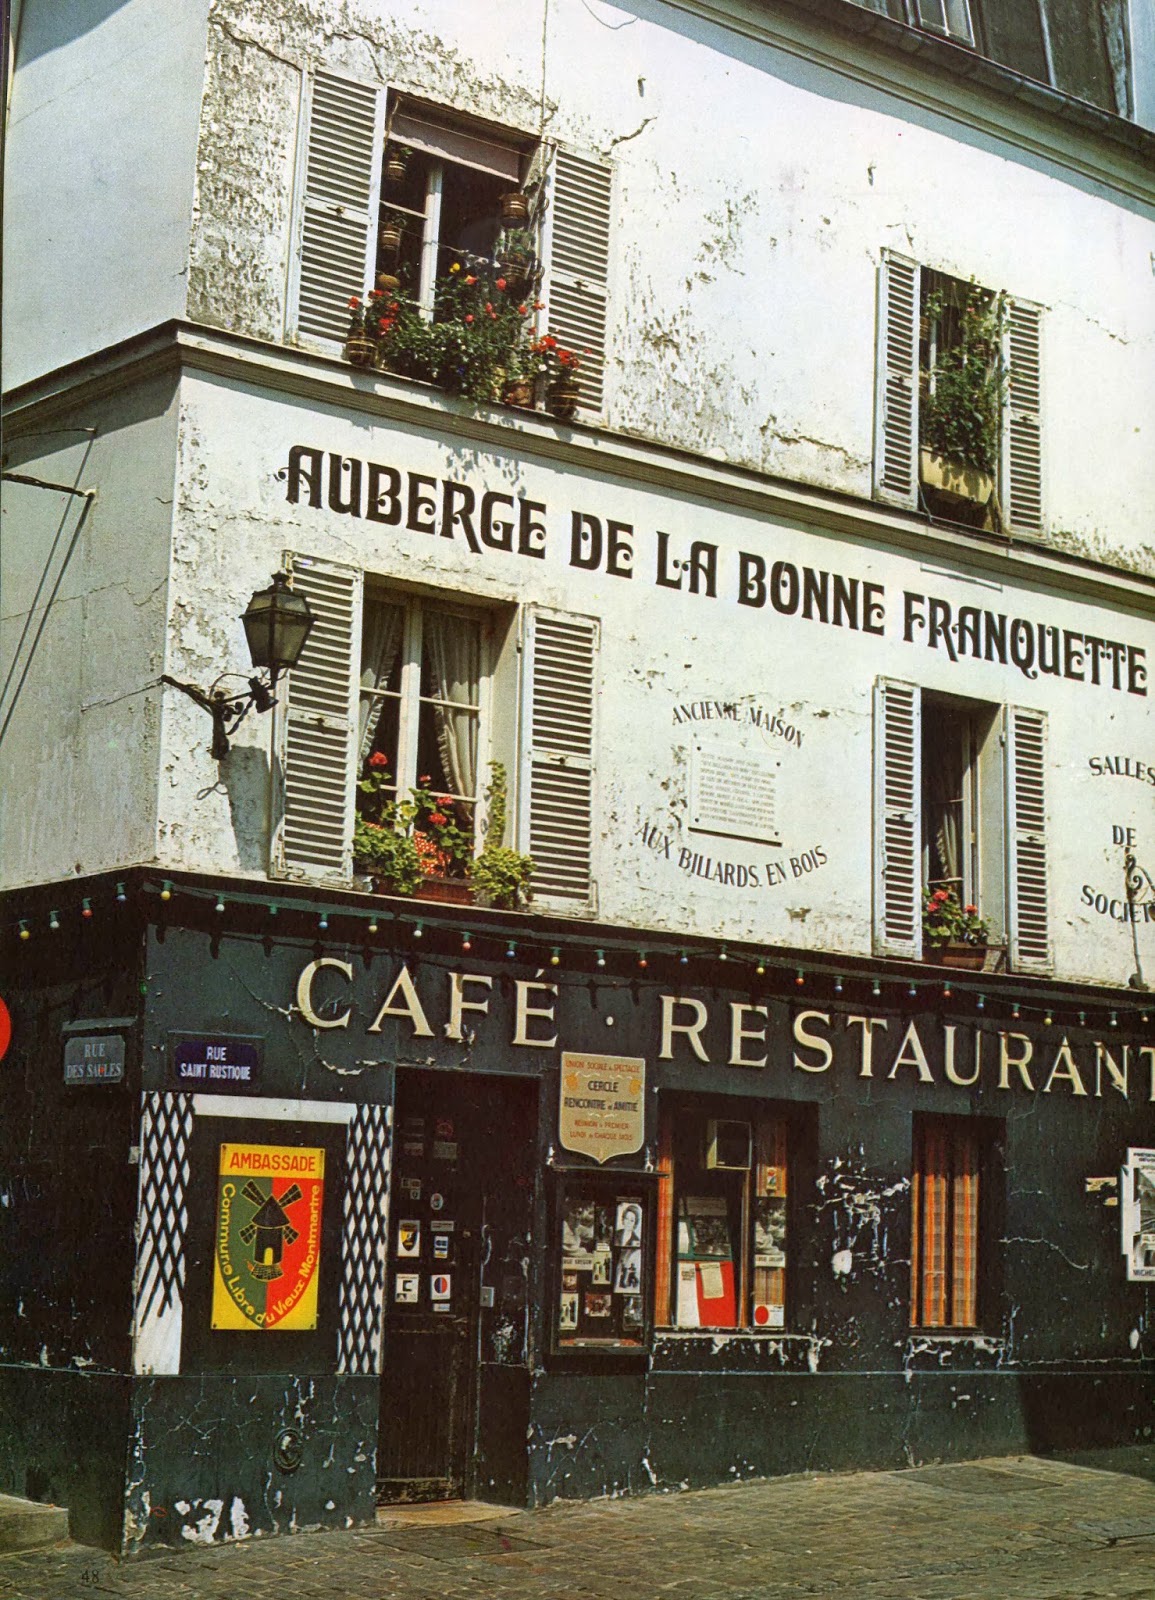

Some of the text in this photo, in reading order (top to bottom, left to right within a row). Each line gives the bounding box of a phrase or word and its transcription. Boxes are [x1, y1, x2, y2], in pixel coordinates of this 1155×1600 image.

[274, 445, 1148, 696] AUBERGE DE LA BONNE FRANQUETTE
[672, 701, 804, 749] ANCIENNE MAISON
[1112, 825, 1137, 848] DE
[635, 822, 674, 859] AUX
[766, 861, 787, 886] EN
[790, 845, 828, 878] BOIS
[297, 956, 1155, 1102] CAFÉ RESTAURANT
[84, 1043, 105, 1058] RUE
[206, 1046, 227, 1061] RUE
[66, 1062, 122, 1078] DES SAULES
[180, 1063, 251, 1080] SAINT RUSTIQUE
[588, 1080, 619, 1092] CERCLE
[229, 1152, 316, 1172] AMBASSADE
[219, 1182, 321, 1325] Commune Libre du Vieux Montmartre
